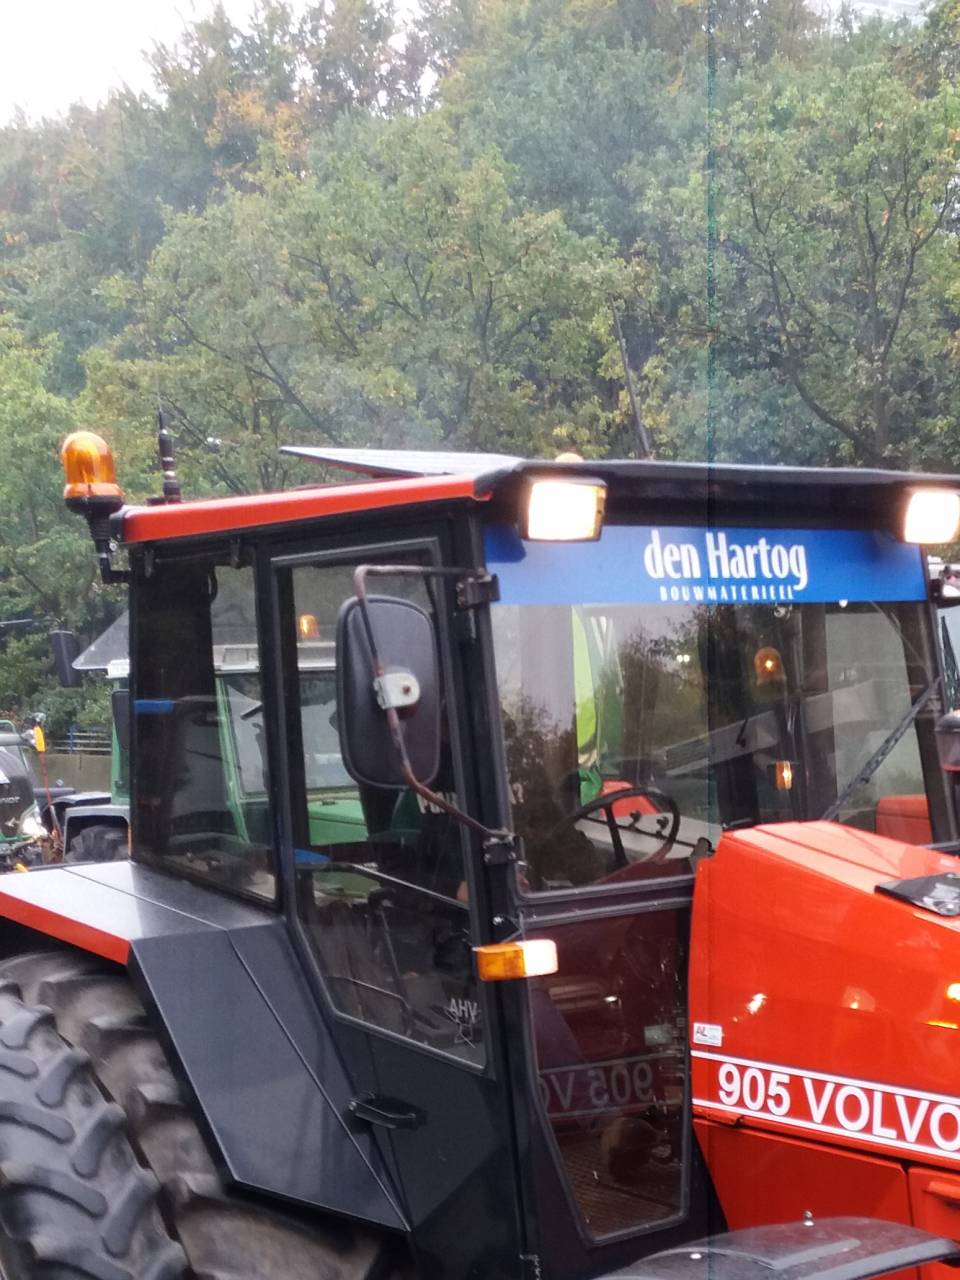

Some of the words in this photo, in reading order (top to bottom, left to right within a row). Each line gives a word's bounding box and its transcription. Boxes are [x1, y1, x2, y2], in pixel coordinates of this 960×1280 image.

[644, 529, 701, 579] den
[705, 531, 808, 591] Hartog
[718, 1064, 790, 1117] 905
